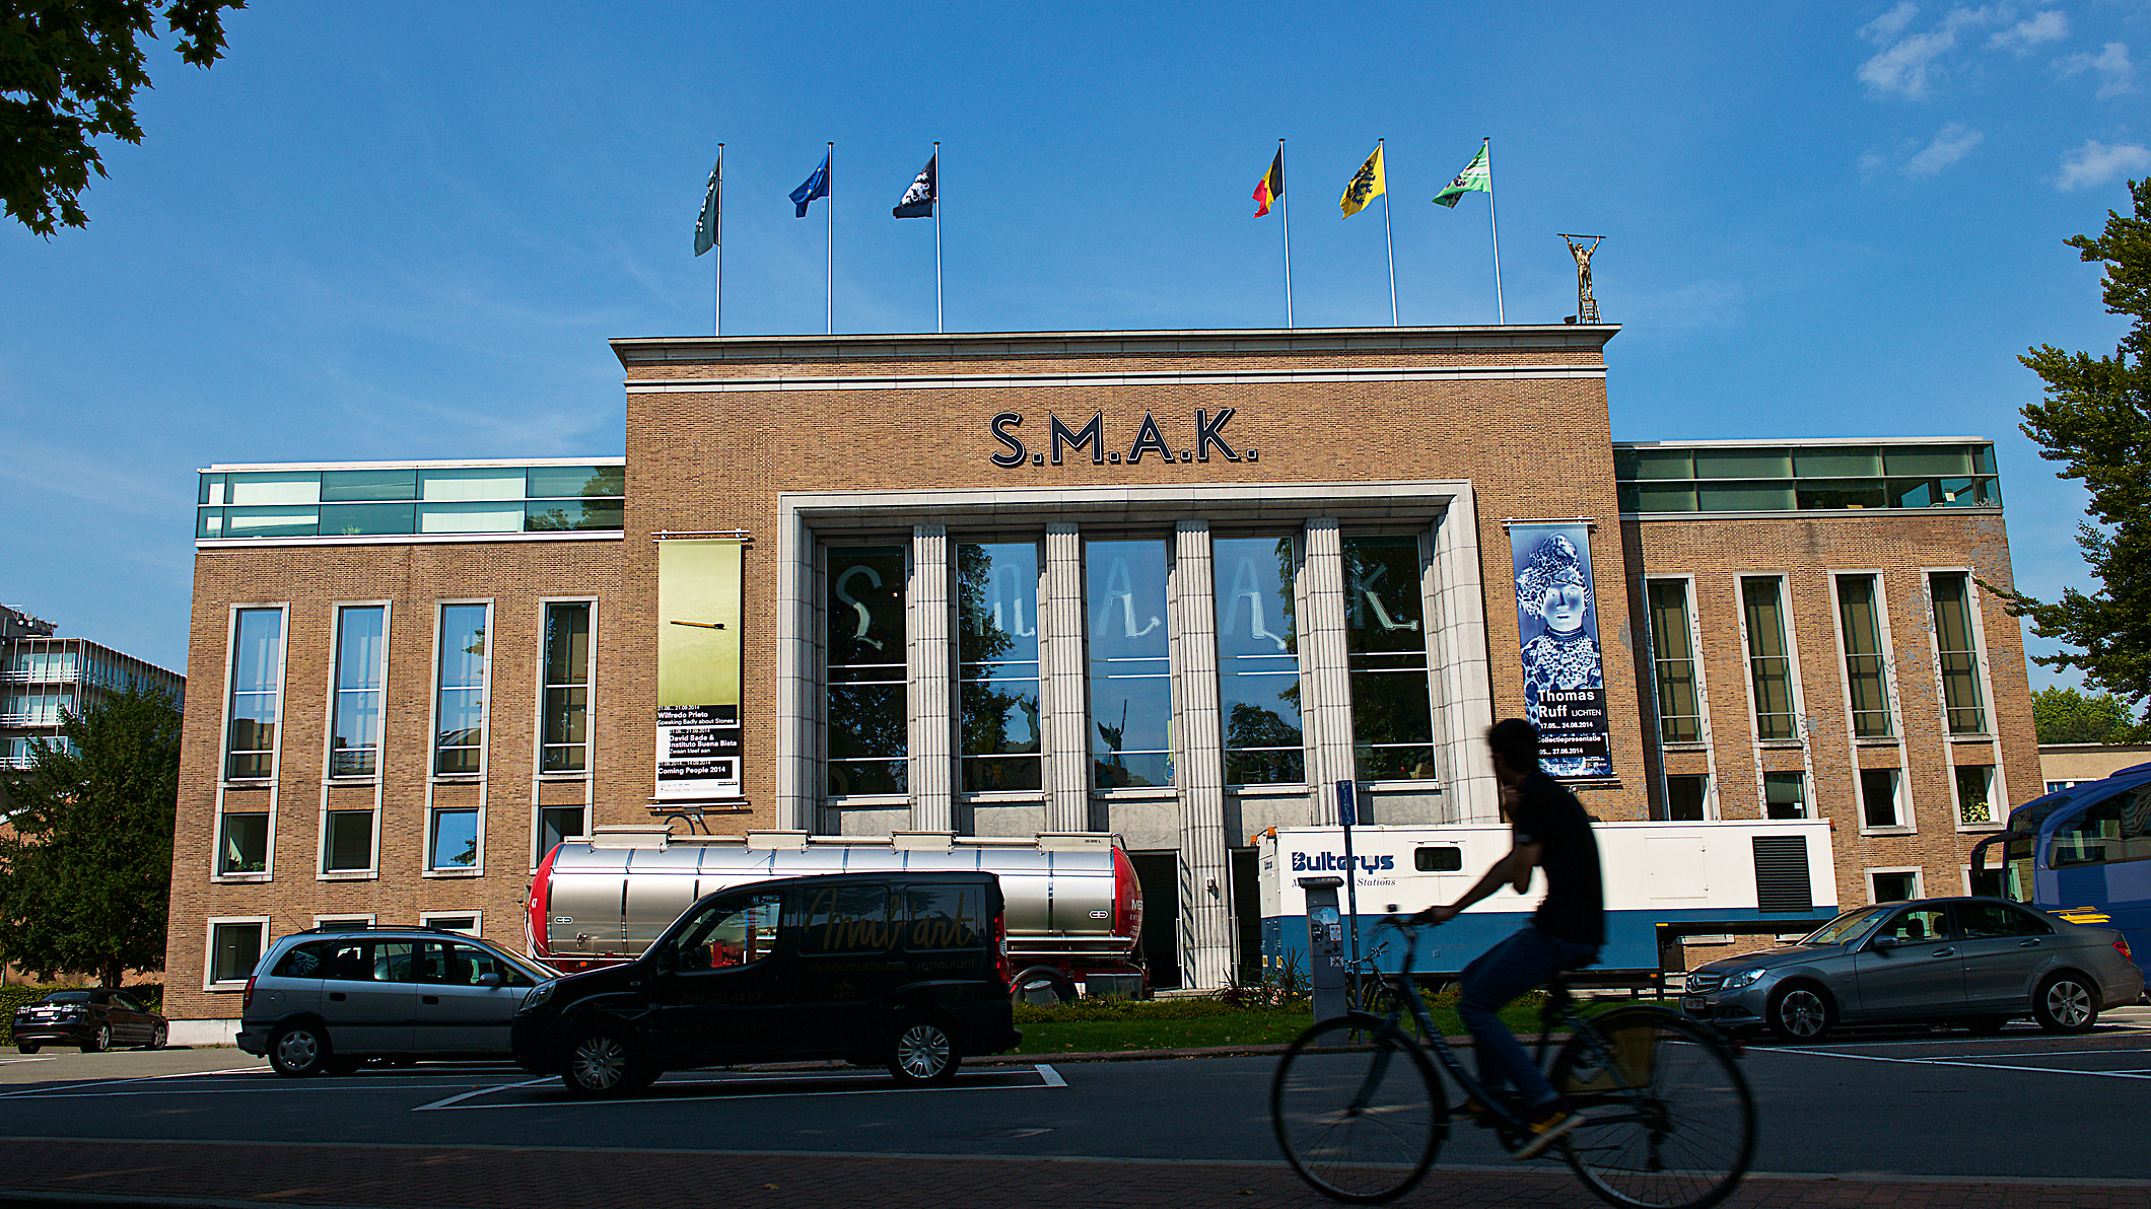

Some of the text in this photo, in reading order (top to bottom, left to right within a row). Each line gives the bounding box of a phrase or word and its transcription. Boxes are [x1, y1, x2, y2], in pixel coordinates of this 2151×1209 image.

[990, 408, 1258, 466] S.M.A.K.
[1537, 690, 1595, 702] Thomas
[1539, 705, 1602, 718] Ruff LICHTEN
[658, 767, 685, 775] Coming
[685, 767, 709, 775] People
[1291, 851, 1395, 875] Bulterys
[1357, 878, 1396, 887] Stations
